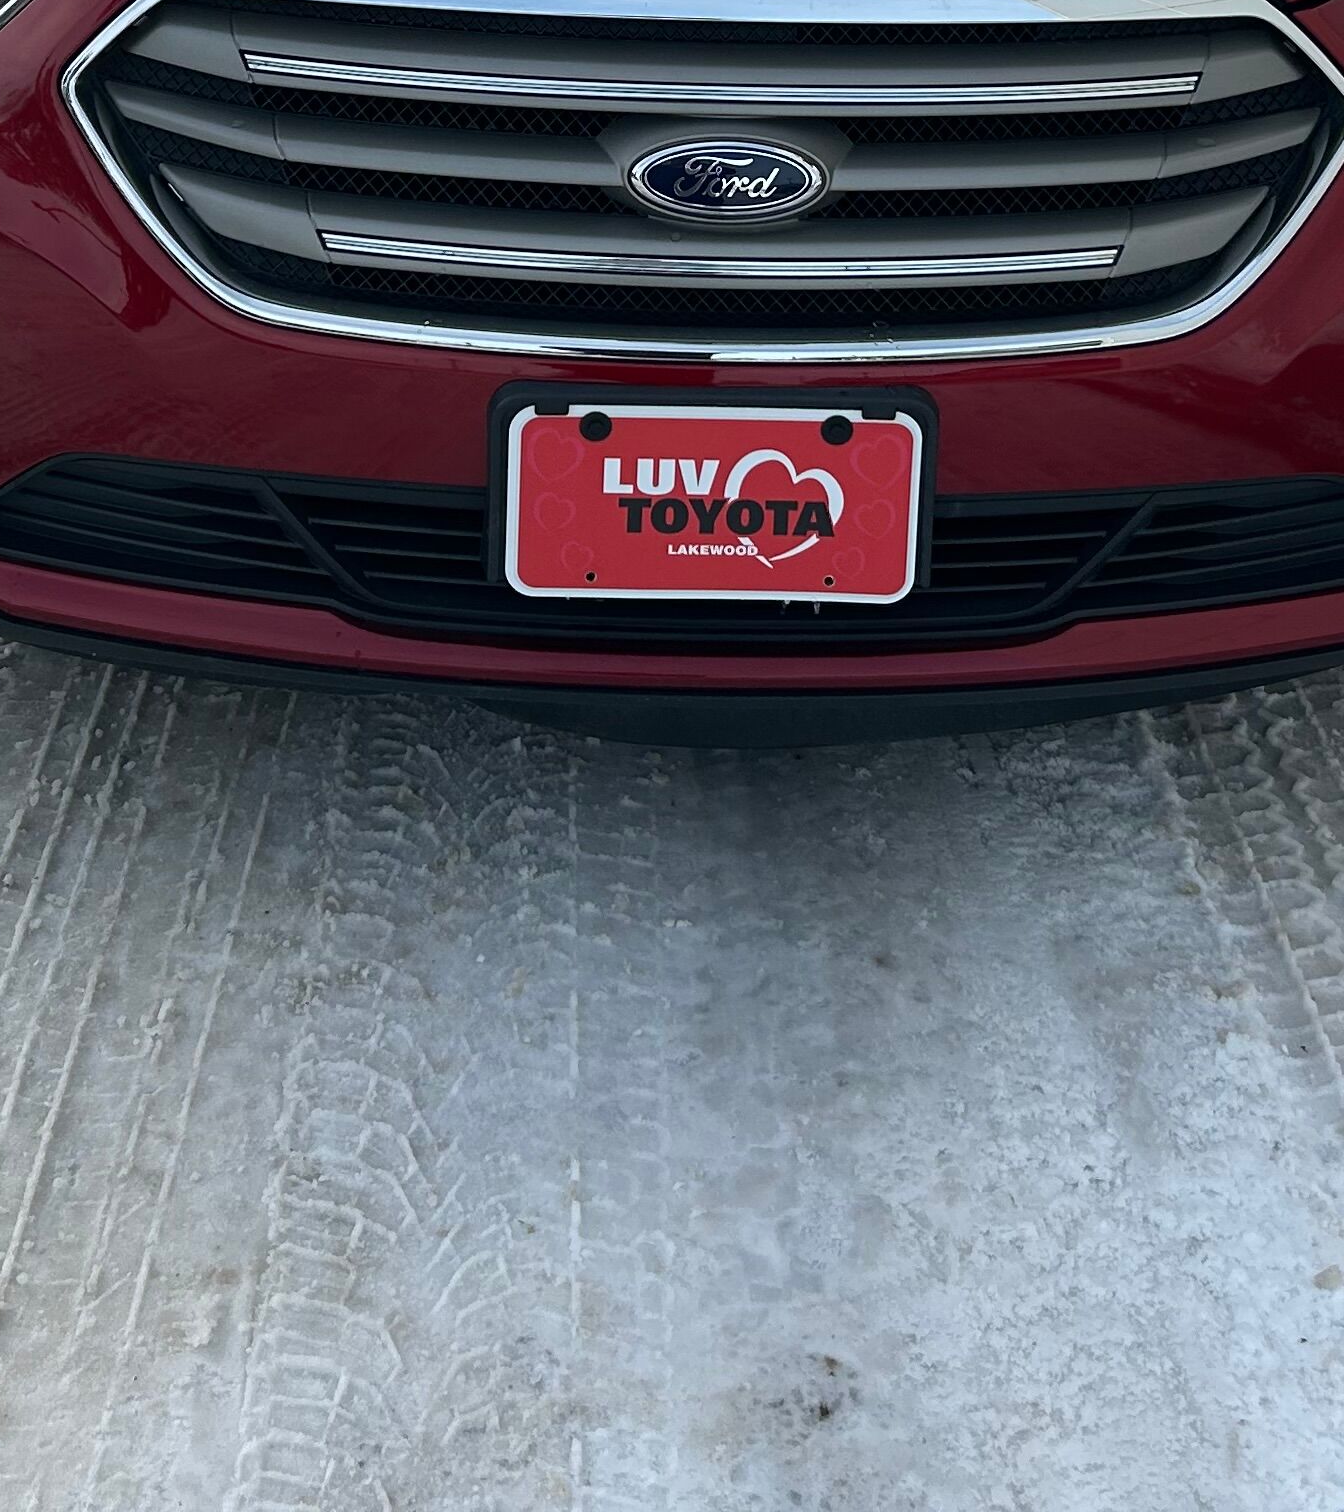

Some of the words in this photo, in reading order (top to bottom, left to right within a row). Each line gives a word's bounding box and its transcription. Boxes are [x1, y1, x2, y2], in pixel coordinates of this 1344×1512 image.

[673, 155, 781, 199] Ford
[602, 457, 721, 496] LUV
[618, 497, 836, 538] TOYOTA
[667, 543, 759, 557] LAKEWOOD
